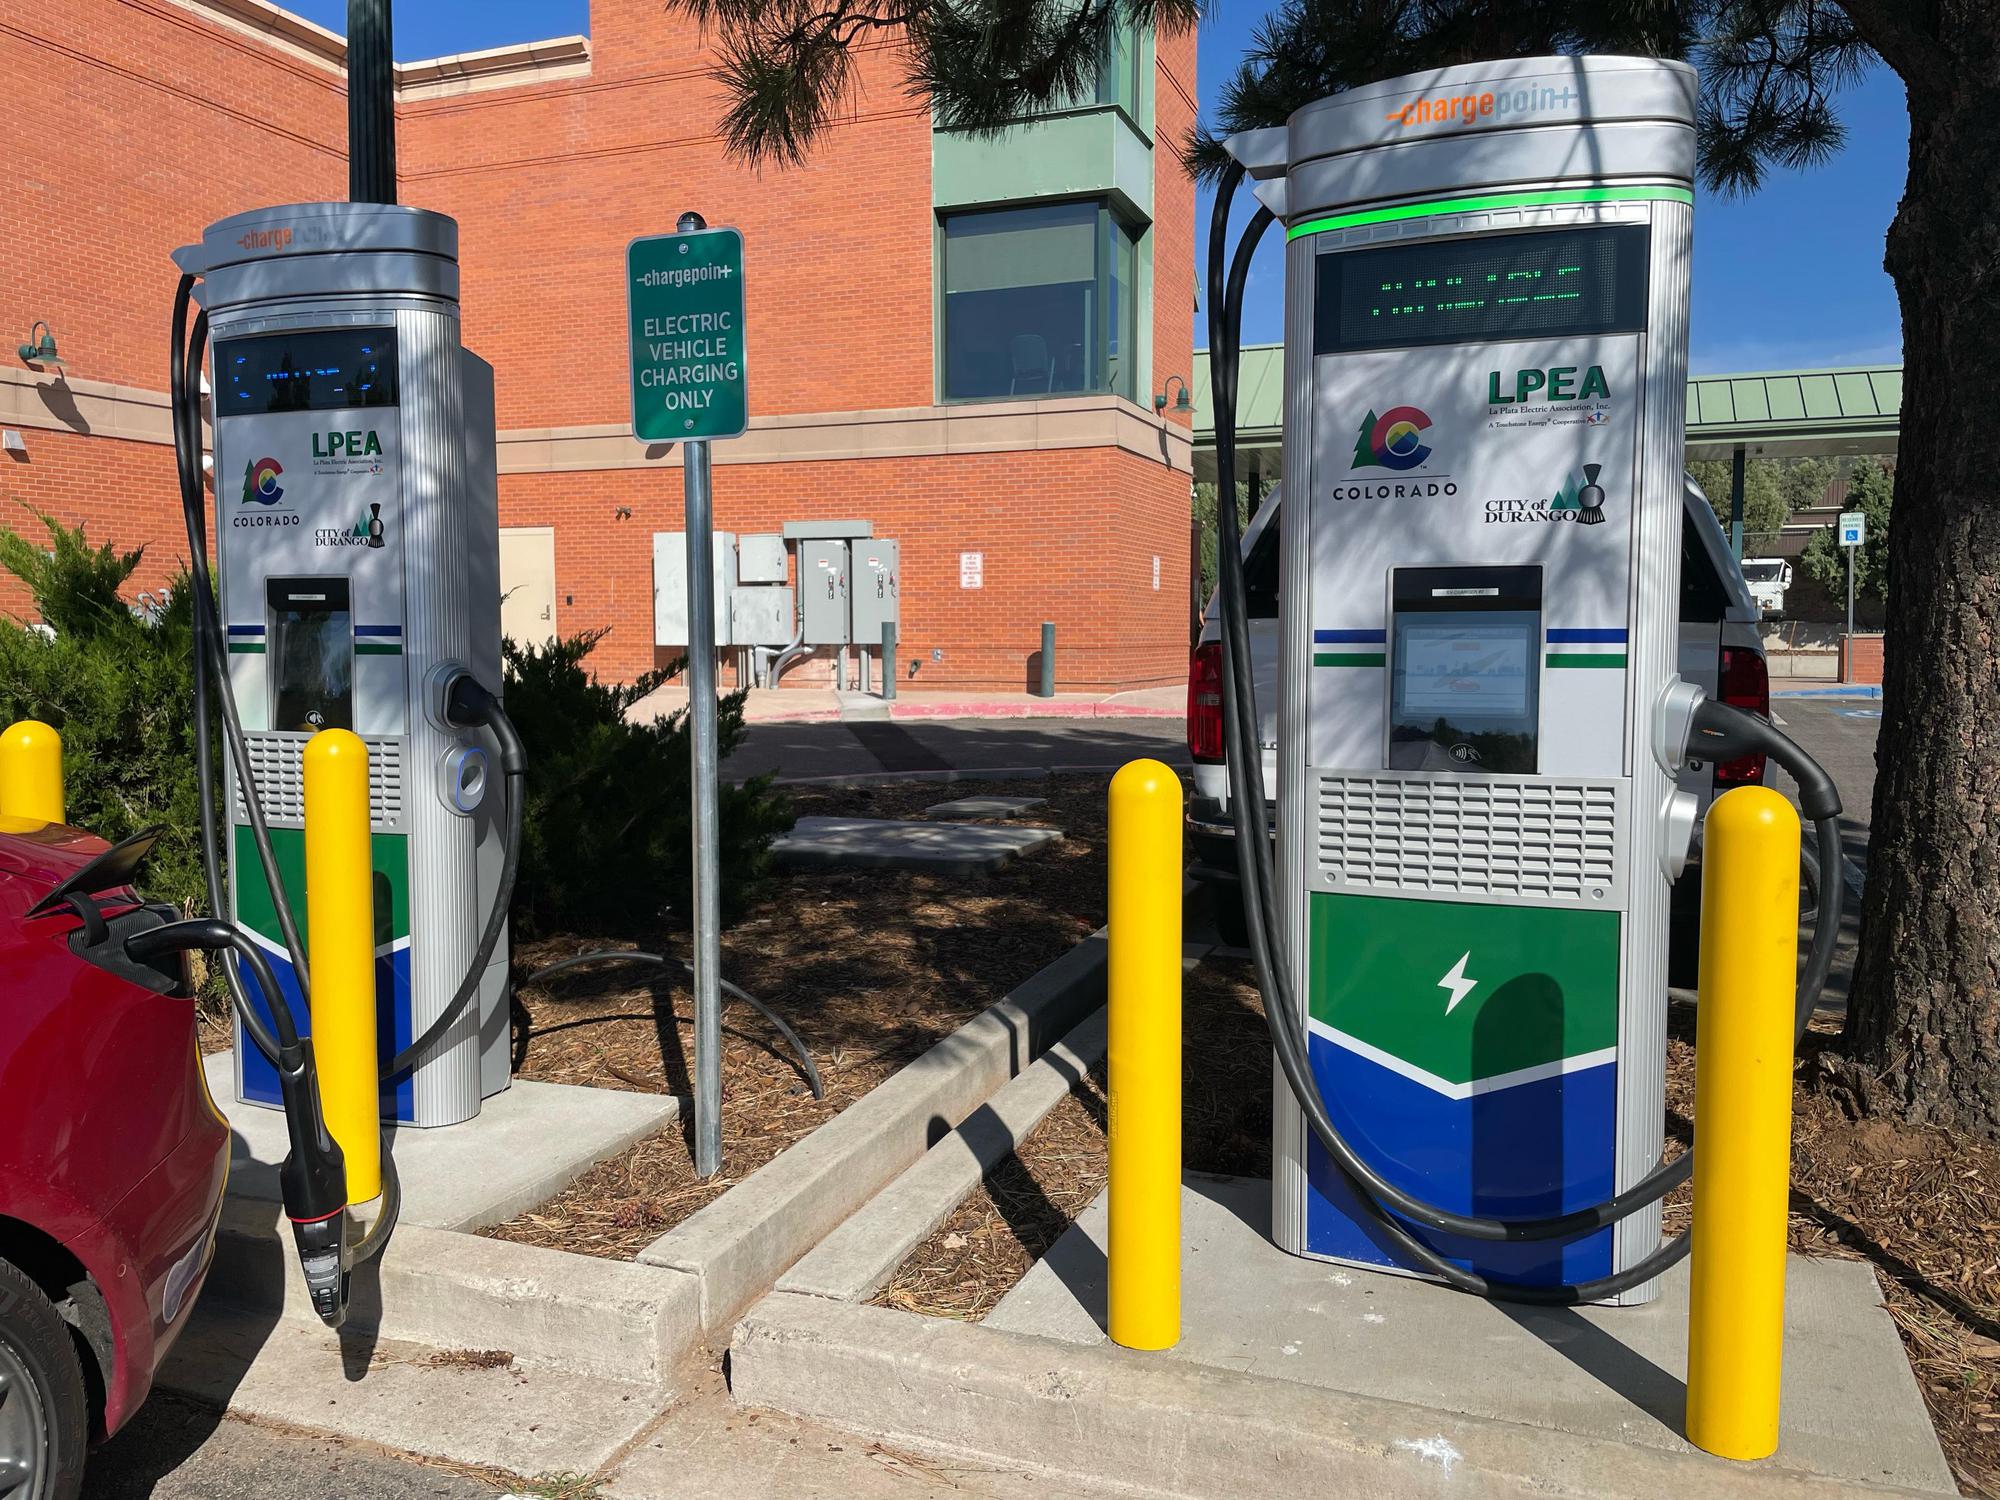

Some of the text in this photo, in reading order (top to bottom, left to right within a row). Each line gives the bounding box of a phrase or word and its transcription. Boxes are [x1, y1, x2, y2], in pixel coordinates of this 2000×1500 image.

[644, 312, 731, 337] ELECTRIC
[649, 337, 727, 361] VEHICLE
[640, 362, 738, 387] CHARGING
[1488, 365, 1611, 404] LPEA
[665, 389, 713, 411] ONLY
[1489, 407, 1498, 415] La
[1500, 406, 1518, 414] Plata
[1520, 405, 1547, 413] Electric
[1550, 404, 1594, 412] Association,
[312, 431, 383, 457] LPEA
[1333, 483, 1458, 501] COLORADO
[1485, 499, 1547, 512] CITY of
[233, 515, 300, 527] COLORADO
[1485, 510, 1577, 523] DURANGO
[315, 528, 351, 538] CITY of
[315, 537, 369, 547] DURANGO
